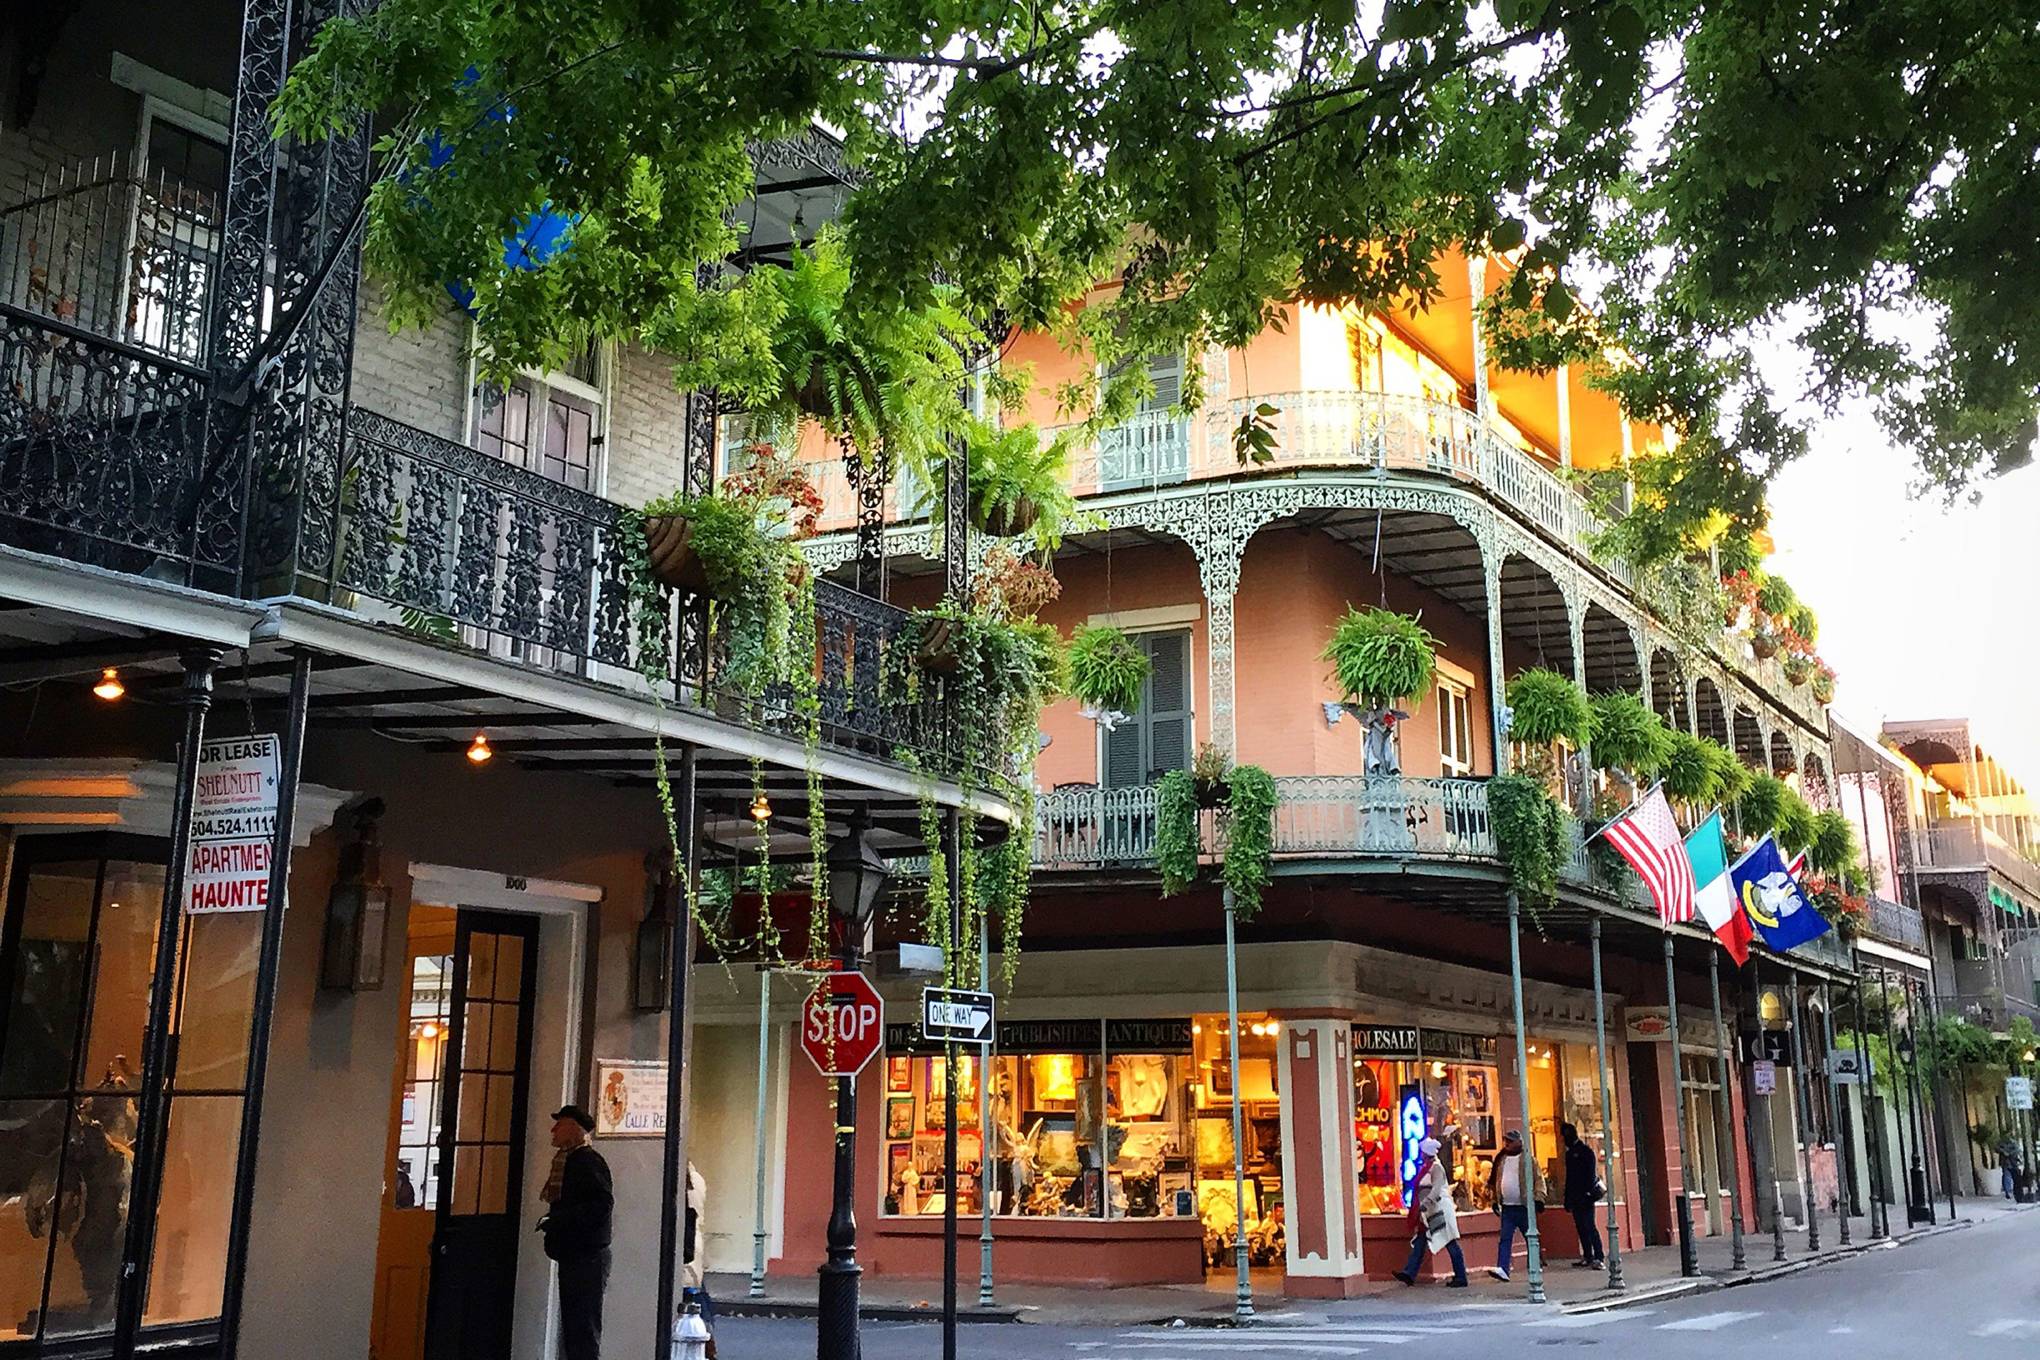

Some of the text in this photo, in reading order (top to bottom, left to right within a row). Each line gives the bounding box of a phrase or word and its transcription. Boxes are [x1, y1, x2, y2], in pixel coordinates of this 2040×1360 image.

[199, 742, 271, 763] OR LEASE
[198, 772, 262, 797] SHELNUTT
[192, 844, 272, 874] APARTMEN
[191, 879, 269, 909] HAUNTE
[808, 1004, 876, 1042] STOP
[932, 1004, 973, 1024] ONE WAY
[1108, 1023, 1191, 1044] ANTIQUES
[1351, 1030, 1417, 1050] HOLESALE
[653, 1112, 667, 1129] RE
[1355, 1107, 1389, 1122] CHMO
